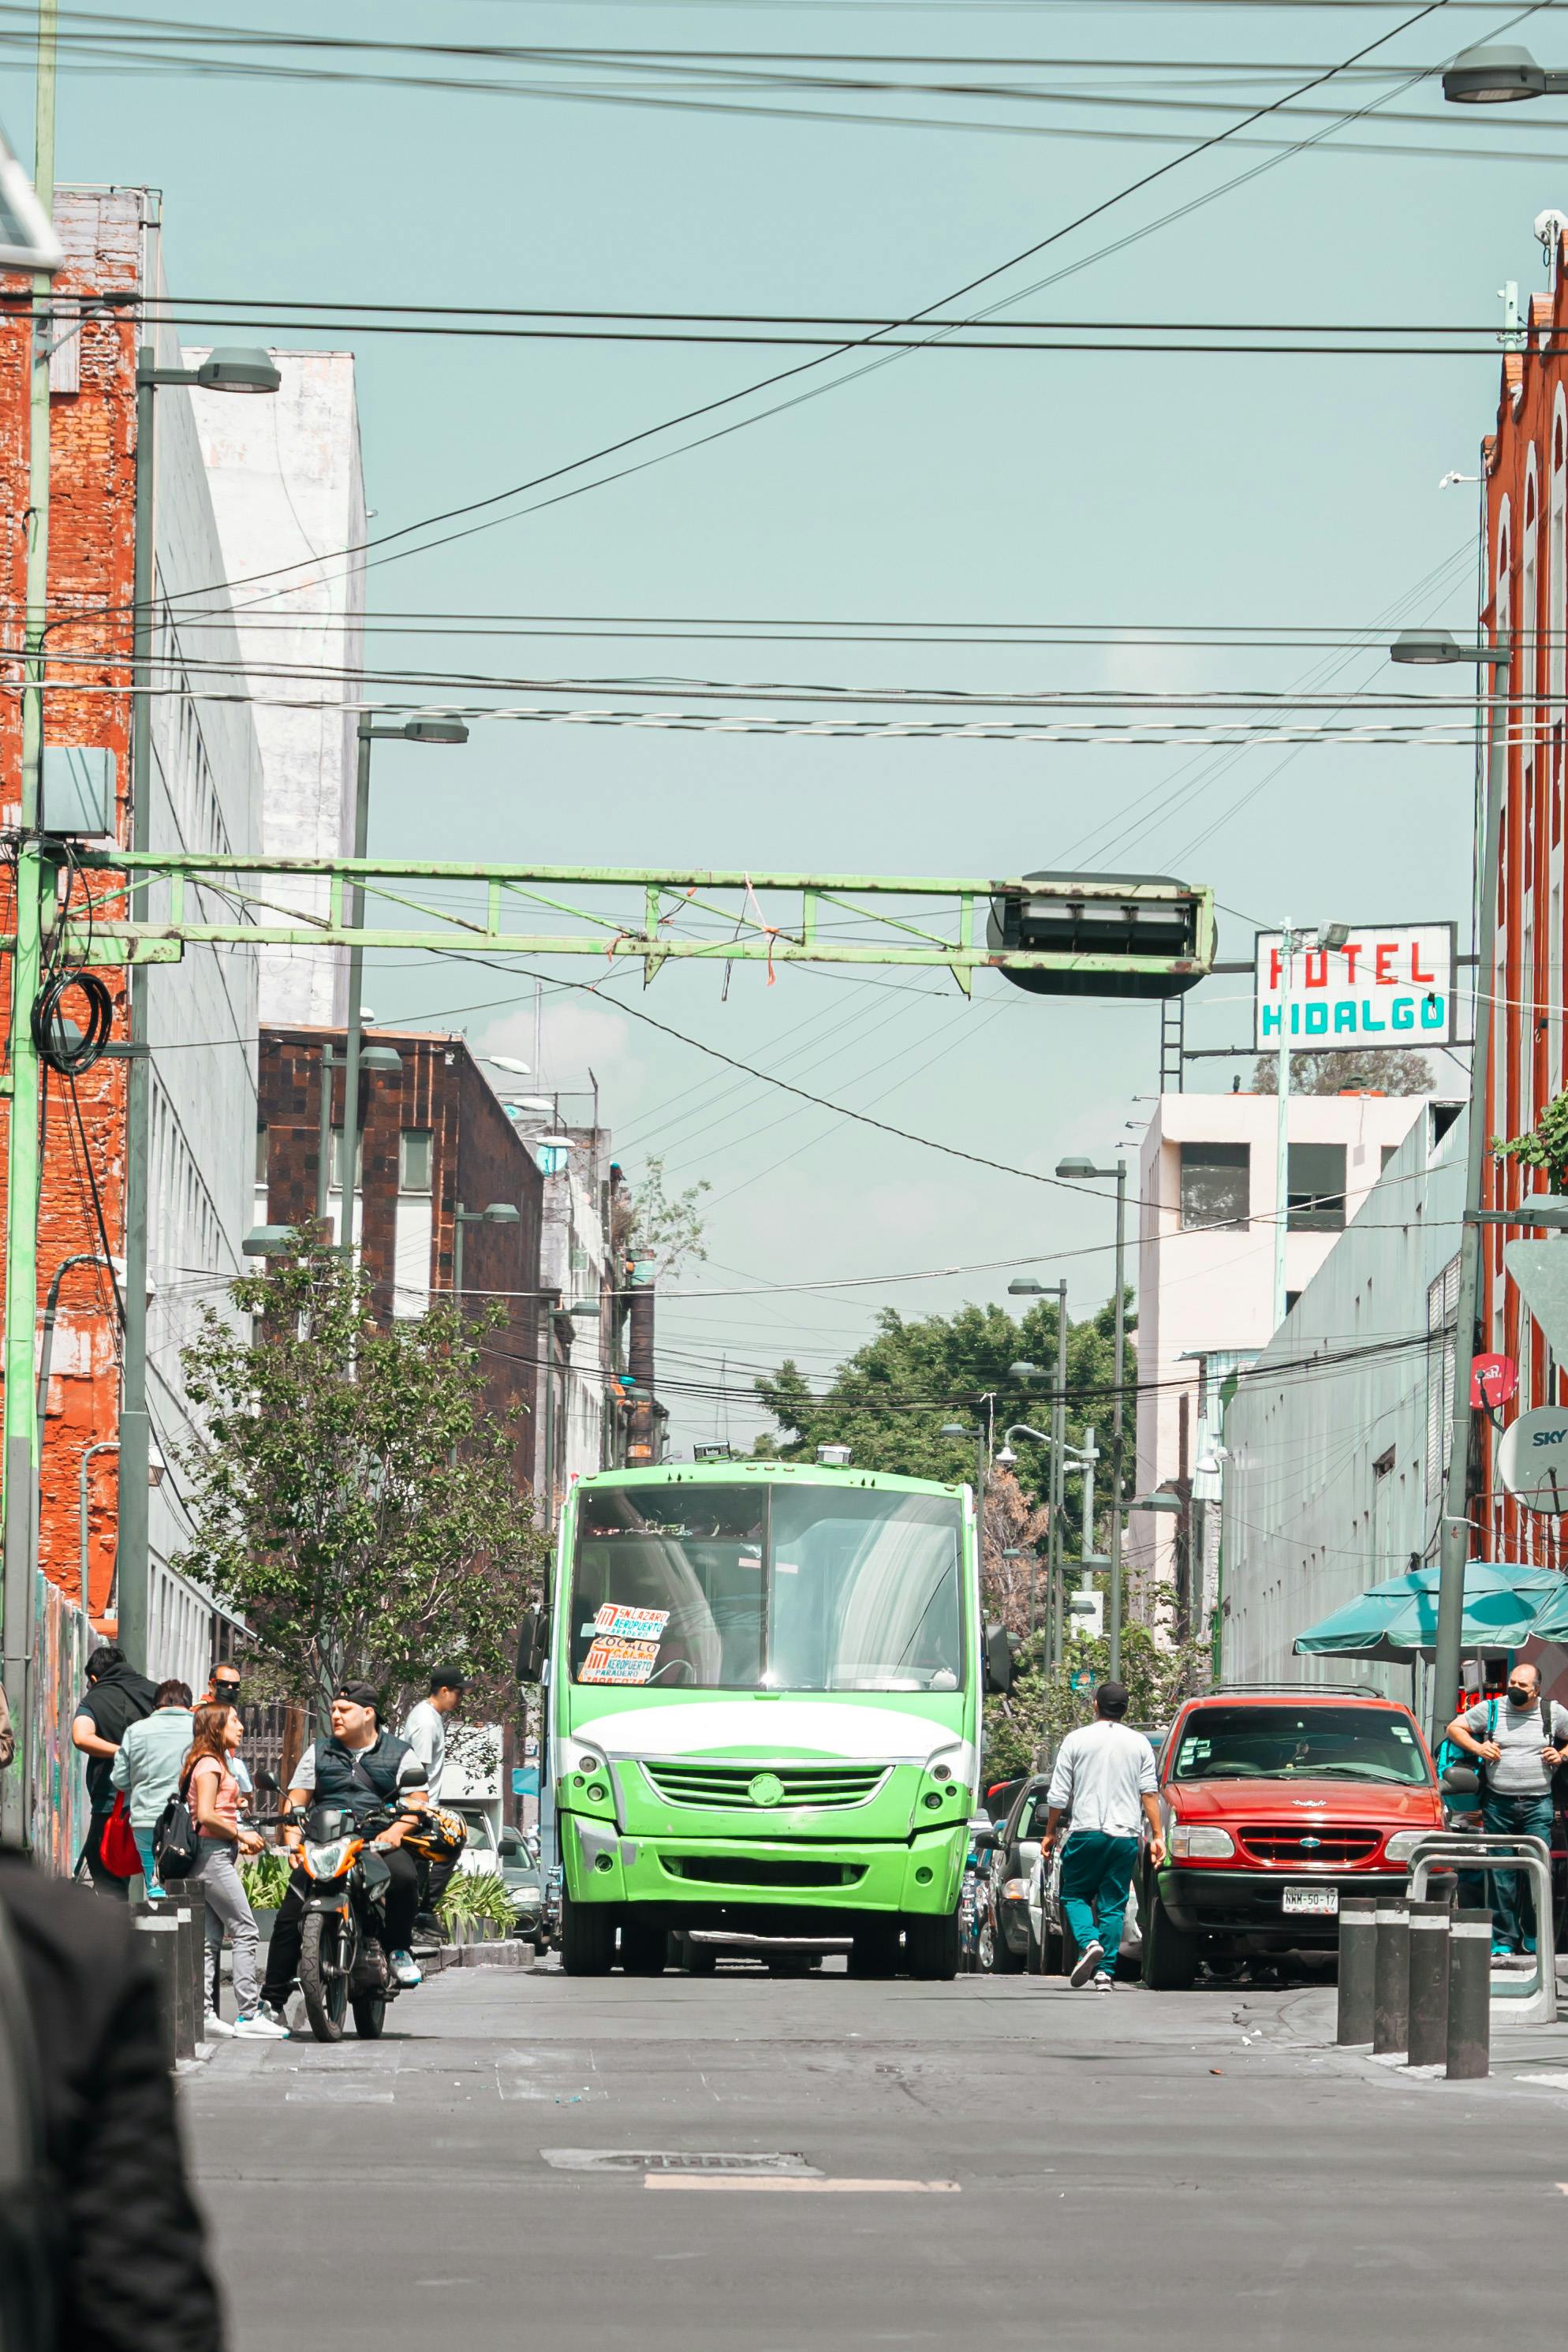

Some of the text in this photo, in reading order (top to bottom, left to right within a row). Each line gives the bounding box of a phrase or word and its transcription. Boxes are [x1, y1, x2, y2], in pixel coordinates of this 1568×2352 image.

[1271, 942, 1435, 989] HOTEL
[1263, 997, 1444, 1036] HIDALGO
[1532, 1428, 1568, 1447] SKY
[606, 1627, 648, 1637] PARADERO
[613, 1618, 663, 1632] AEROPUERTO
[607, 1659, 653, 1671] AEROPUERTO
[595, 1669, 638, 1678] PARADERO
